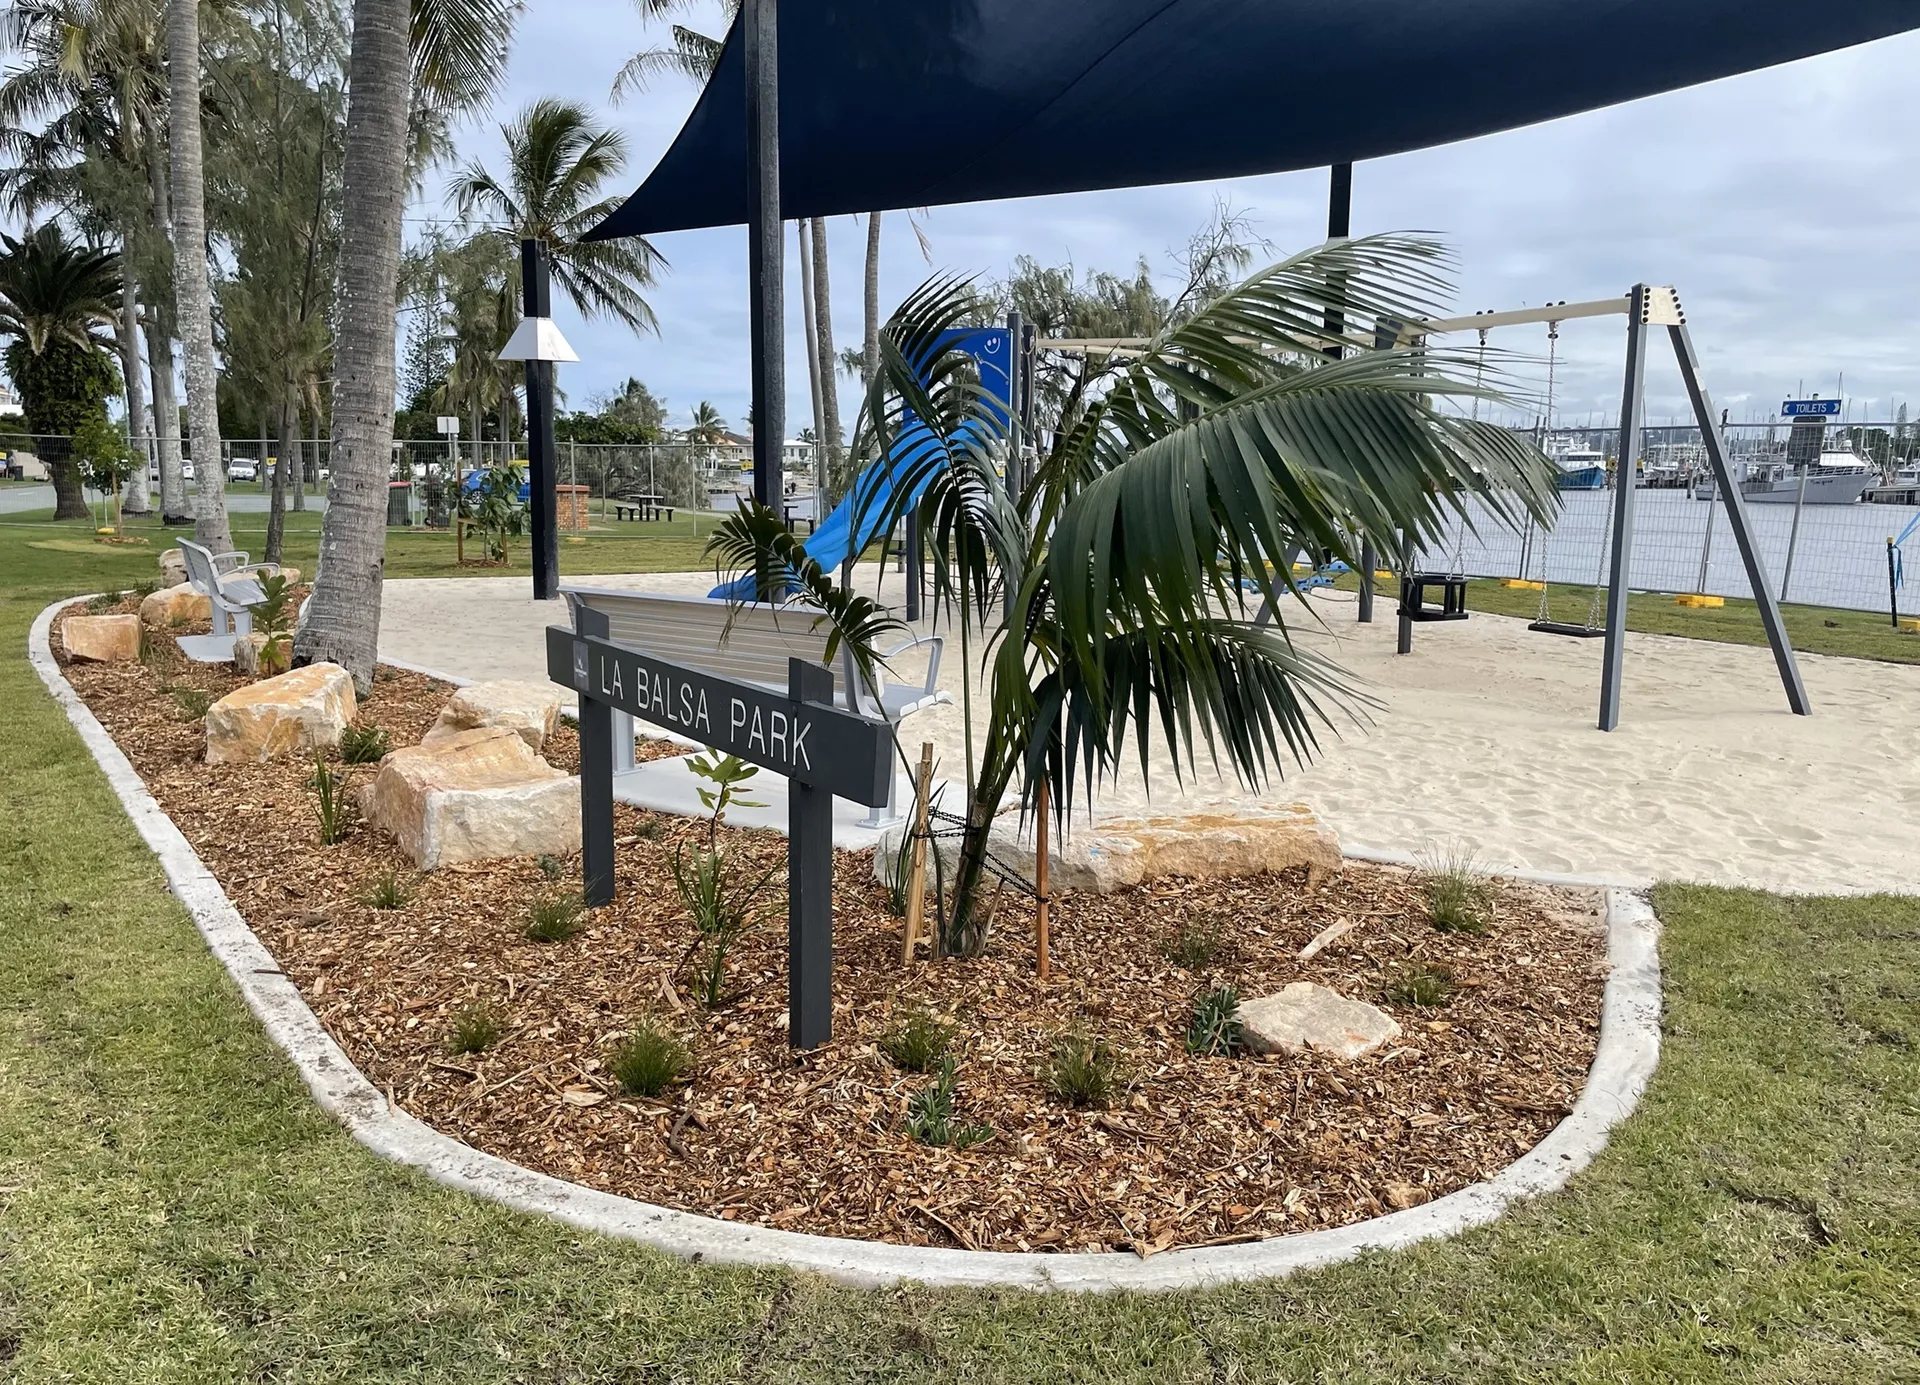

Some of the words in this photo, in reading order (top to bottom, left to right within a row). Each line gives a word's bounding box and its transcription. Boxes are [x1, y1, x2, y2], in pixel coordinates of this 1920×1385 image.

[1796, 403, 1827, 413] TOILETS
[600, 655, 624, 700] LA
[637, 667, 711, 734] BALSA
[730, 697, 812, 771] PARK
